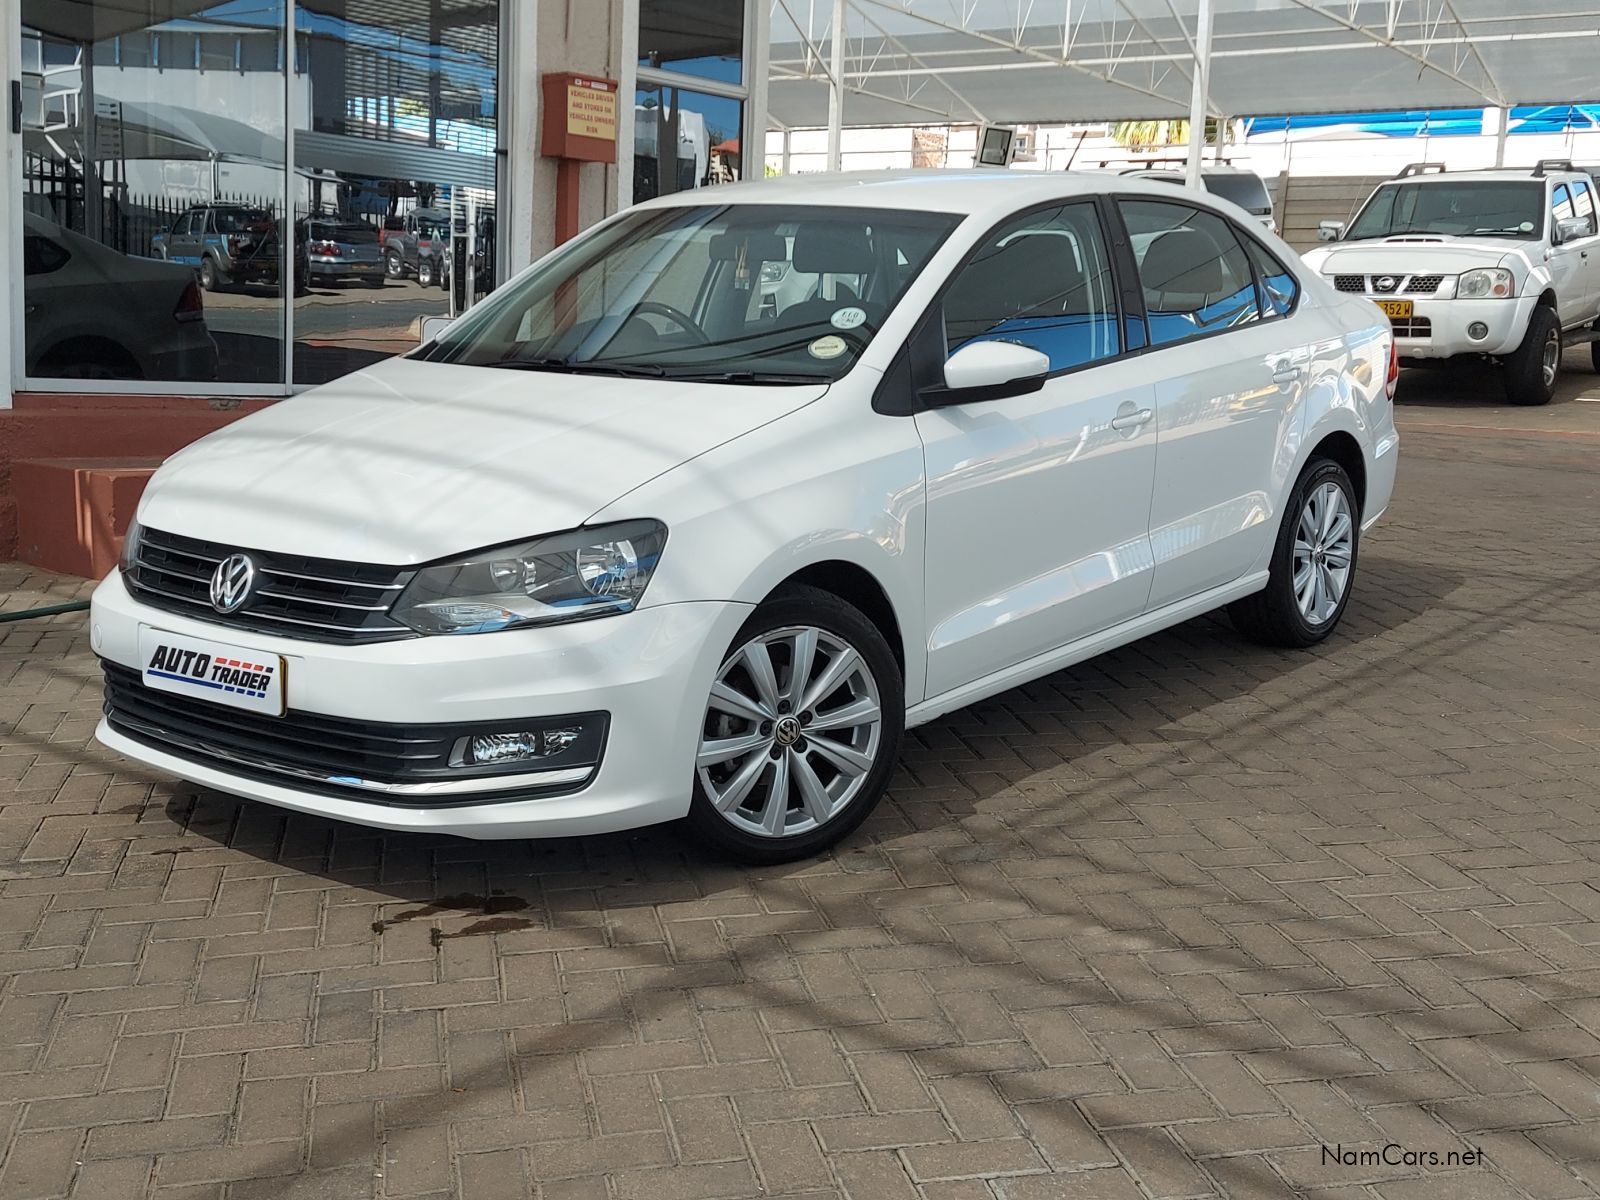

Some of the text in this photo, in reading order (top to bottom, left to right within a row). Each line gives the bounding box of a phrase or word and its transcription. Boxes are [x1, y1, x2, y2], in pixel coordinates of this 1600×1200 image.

[570, 90, 594, 99] VEHICLES
[150, 645, 271, 691] AUTO TRADER
